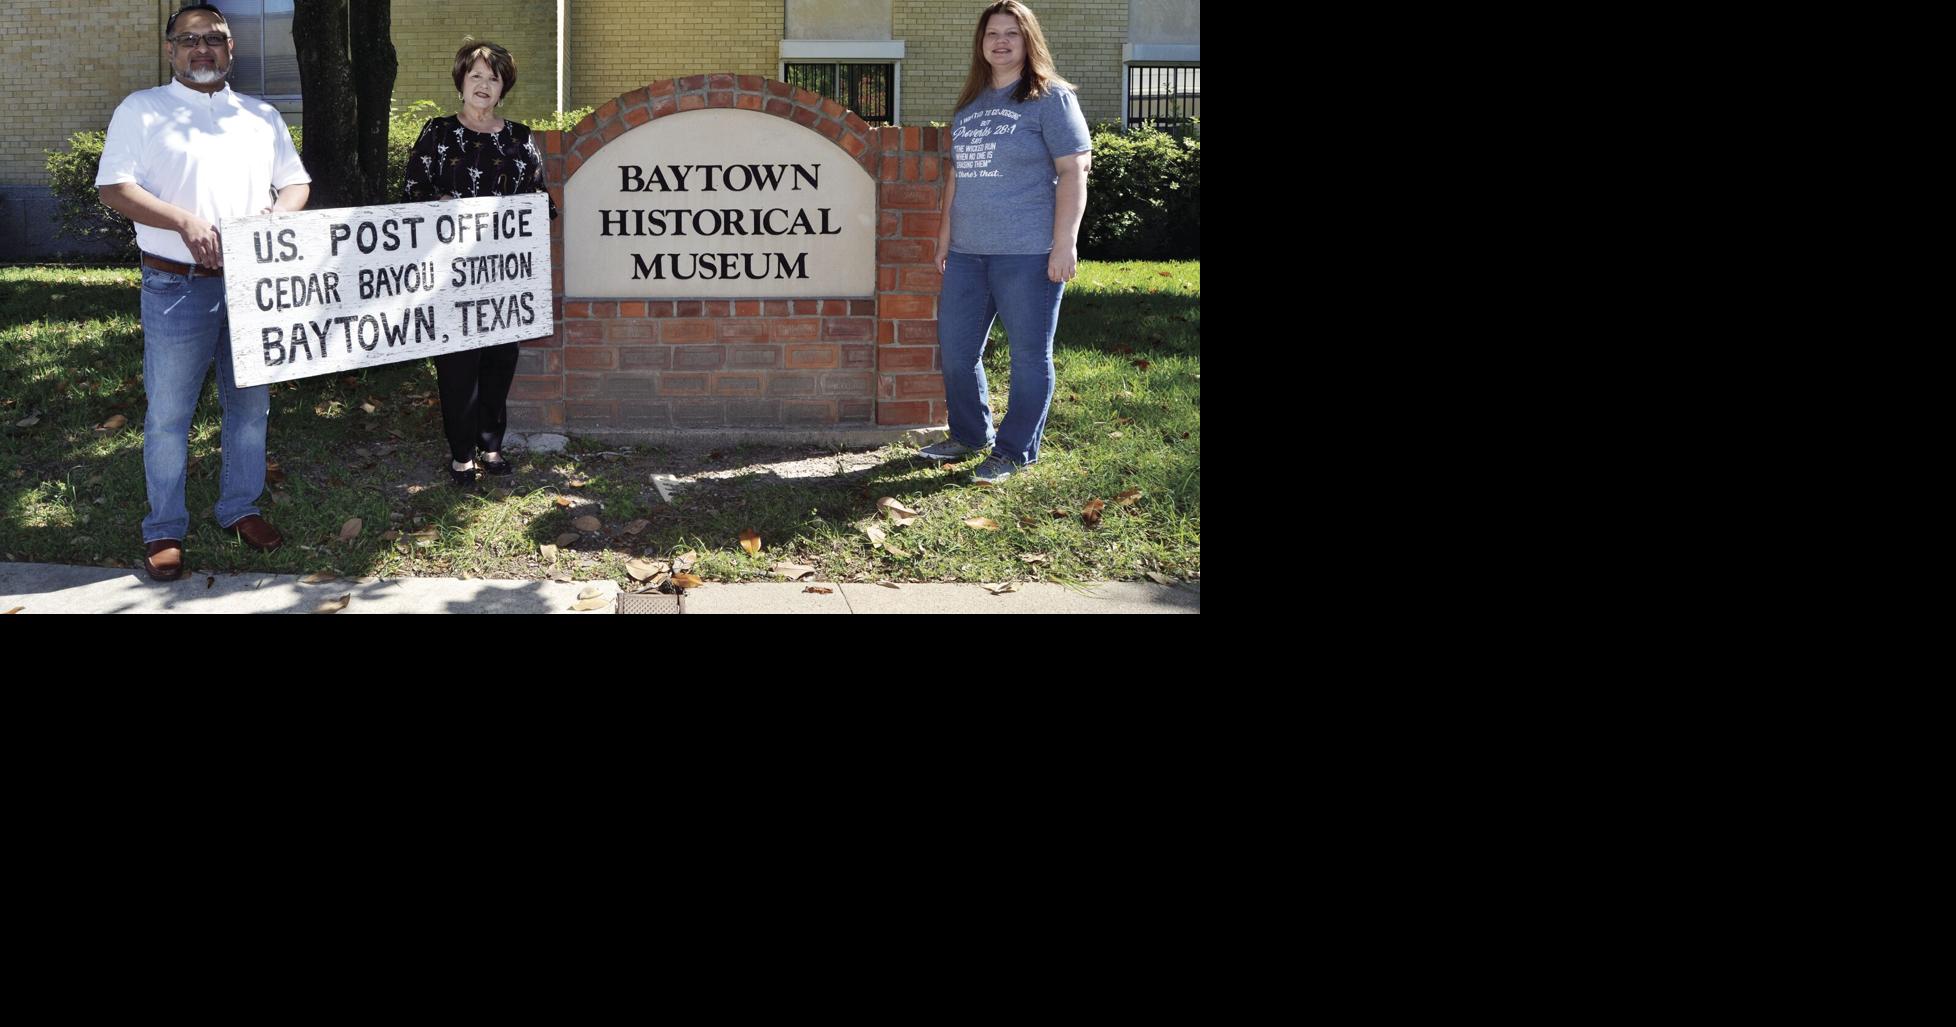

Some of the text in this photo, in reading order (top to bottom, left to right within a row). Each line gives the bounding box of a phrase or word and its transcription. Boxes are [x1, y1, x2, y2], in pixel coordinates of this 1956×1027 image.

[952, 124, 1017, 141] Proverbs 28:1
[955, 151, 993, 161] WHEN NO ONE IS
[965, 144, 984, 152] WICKED
[617, 163, 822, 192] BAYTOWN
[253, 208, 533, 264] U.S. POST OFFICE
[598, 207, 842, 236] HISTORICAL
[630, 252, 810, 280] MUSEUM
[255, 251, 533, 312] CEDAR BAYOU STATION
[261, 291, 536, 367] BAYTOWN, TEXAS
